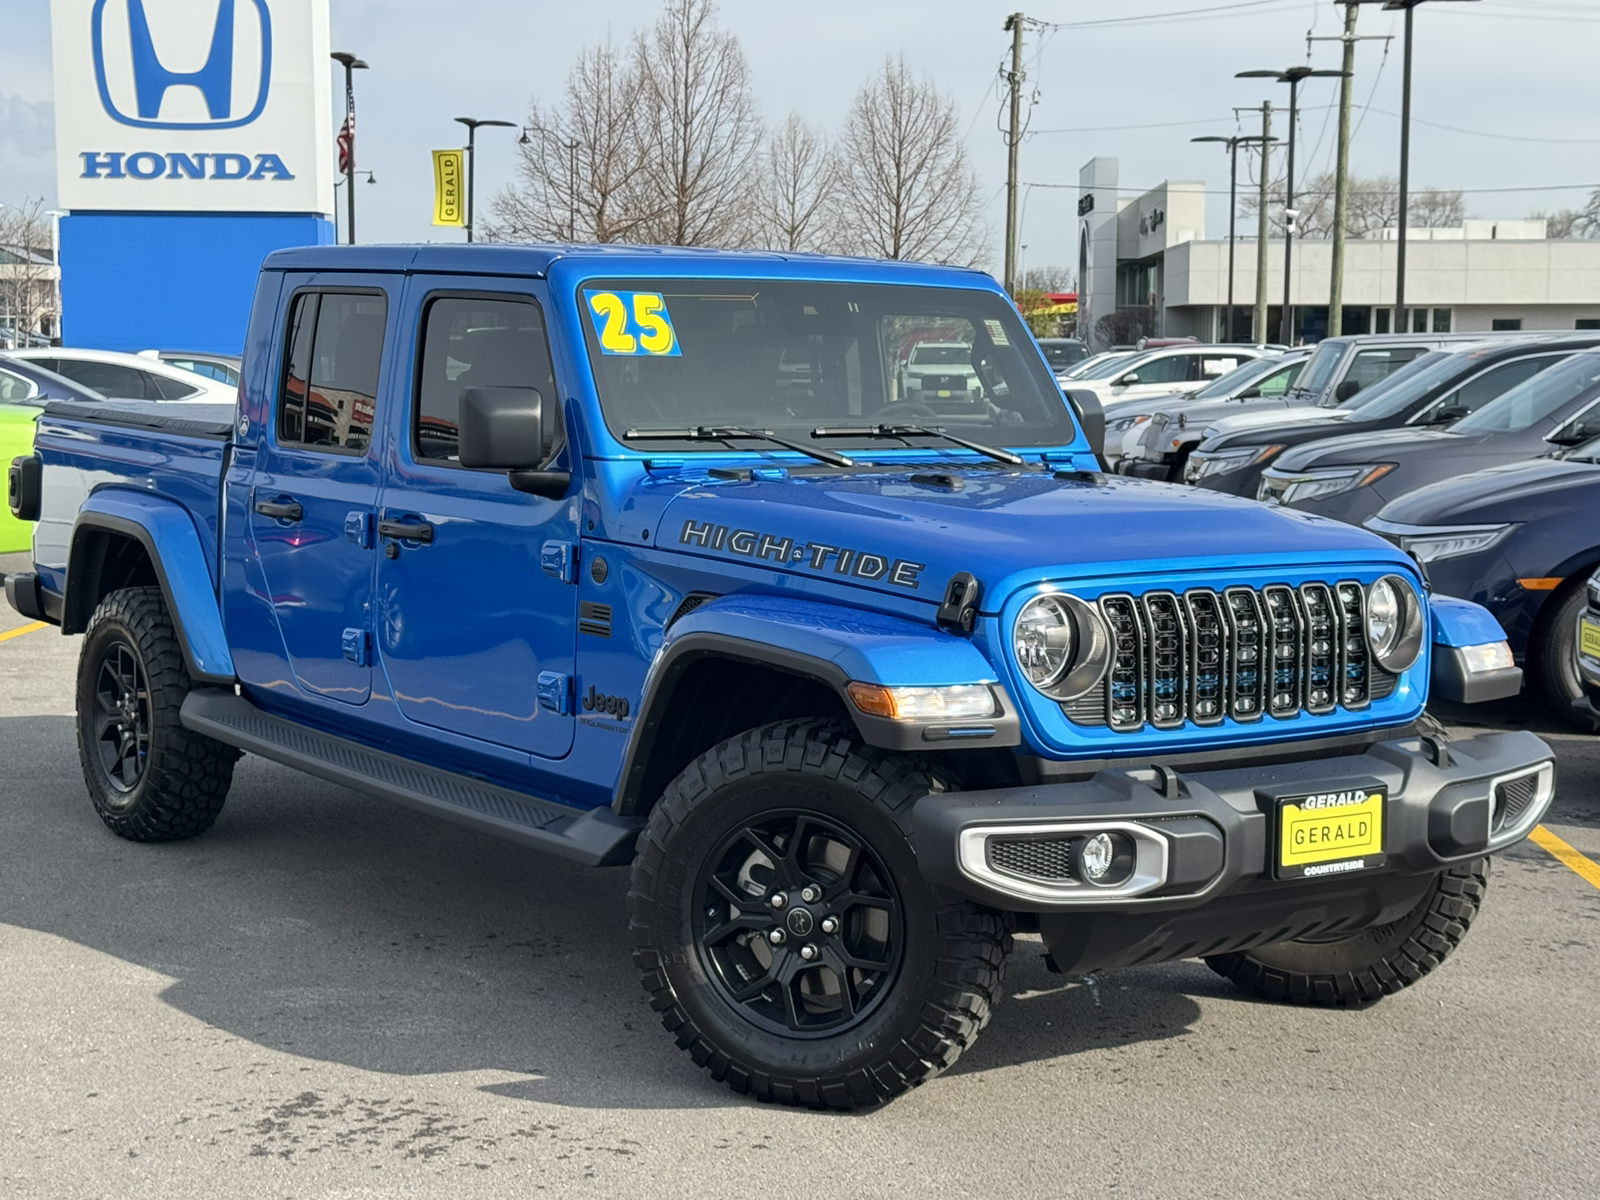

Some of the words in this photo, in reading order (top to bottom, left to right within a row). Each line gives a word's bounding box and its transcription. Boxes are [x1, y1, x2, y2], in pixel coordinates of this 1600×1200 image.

[79, 151, 296, 180] HONDA
[444, 159, 455, 216] GERALD
[590, 293, 674, 354] 25
[679, 519, 794, 563] HIGH
[806, 541, 926, 589] TIDE
[582, 685, 629, 721] Jeep
[1304, 790, 1366, 809] GERALD
[1295, 821, 1368, 845] GERALD
[1304, 859, 1365, 876] COUNTRYSIDE
